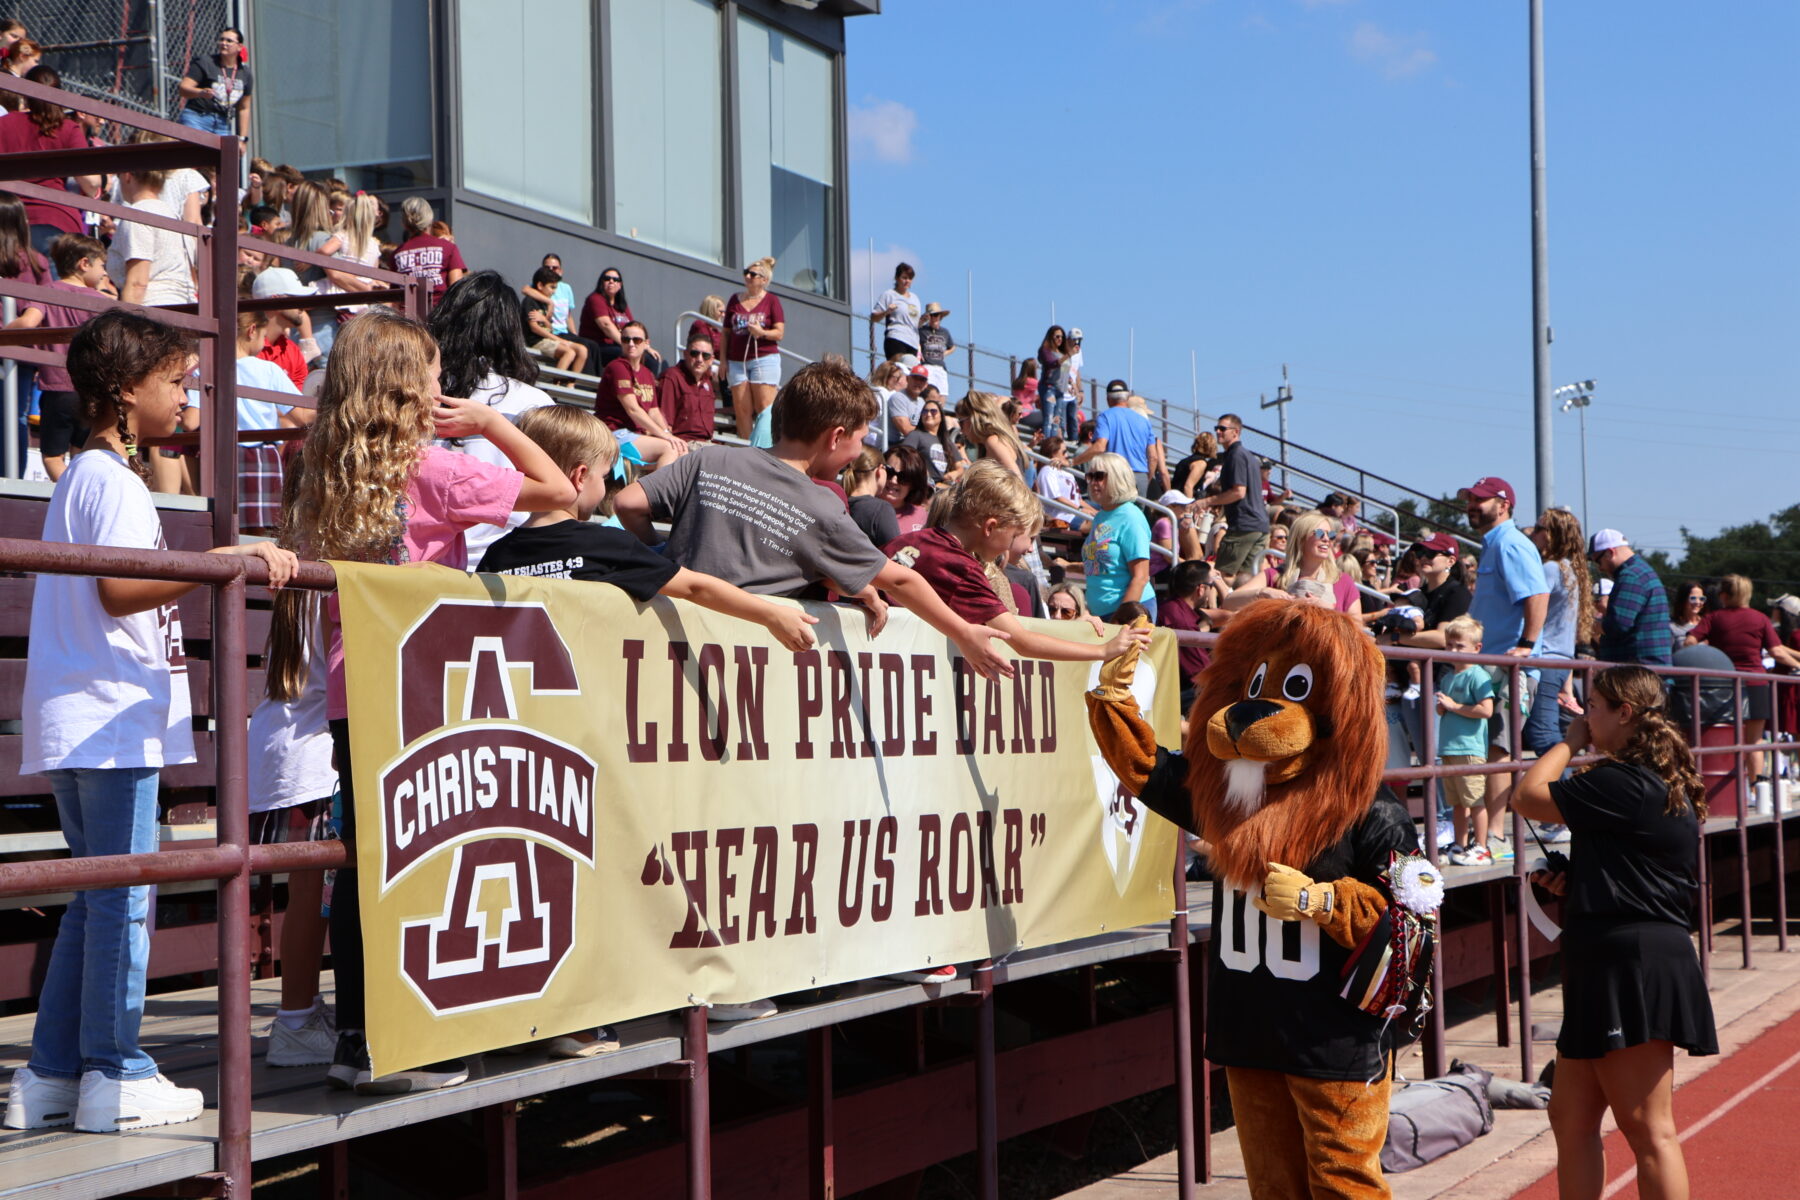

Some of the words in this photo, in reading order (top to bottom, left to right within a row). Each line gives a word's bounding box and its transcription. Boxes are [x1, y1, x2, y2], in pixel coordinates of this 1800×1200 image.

[420, 251, 443, 265] GOD
[699, 470, 713, 479] That
[719, 475, 732, 484] why
[741, 482, 758, 494] labor
[758, 489, 772, 500] and
[771, 495, 790, 510] strive,
[790, 505, 816, 524] because
[699, 489, 711, 497] who
[717, 493, 729, 503] the
[728, 498, 748, 510] Savior
[748, 504, 757, 513] of
[755, 508, 764, 517] all
[762, 513, 786, 530] people,
[786, 525, 800, 536] and
[699, 499, 728, 513] especially
[728, 507, 736, 515] of
[735, 509, 754, 523] those
[753, 519, 767, 530] who
[767, 524, 790, 542] believe.
[705, 480, 720, 489] have
[719, 484, 732, 494] put
[732, 489, 743, 498] our
[743, 492, 760, 505] hope
[759, 499, 766, 507] in
[766, 503, 778, 513] the
[777, 508, 794, 523] living
[794, 518, 808, 531] God,
[498, 560, 564, 576] CLESIASTES
[566, 556, 584, 569] 4:9
[768, 539, 780, 551] Tim
[780, 546, 794, 557] 4:10
[622, 639, 770, 763] LION
[793, 648, 937, 759] PRIDE
[952, 655, 1057, 756] BAND
[393, 745, 590, 851] CHRISTIAN
[838, 815, 898, 928] US
